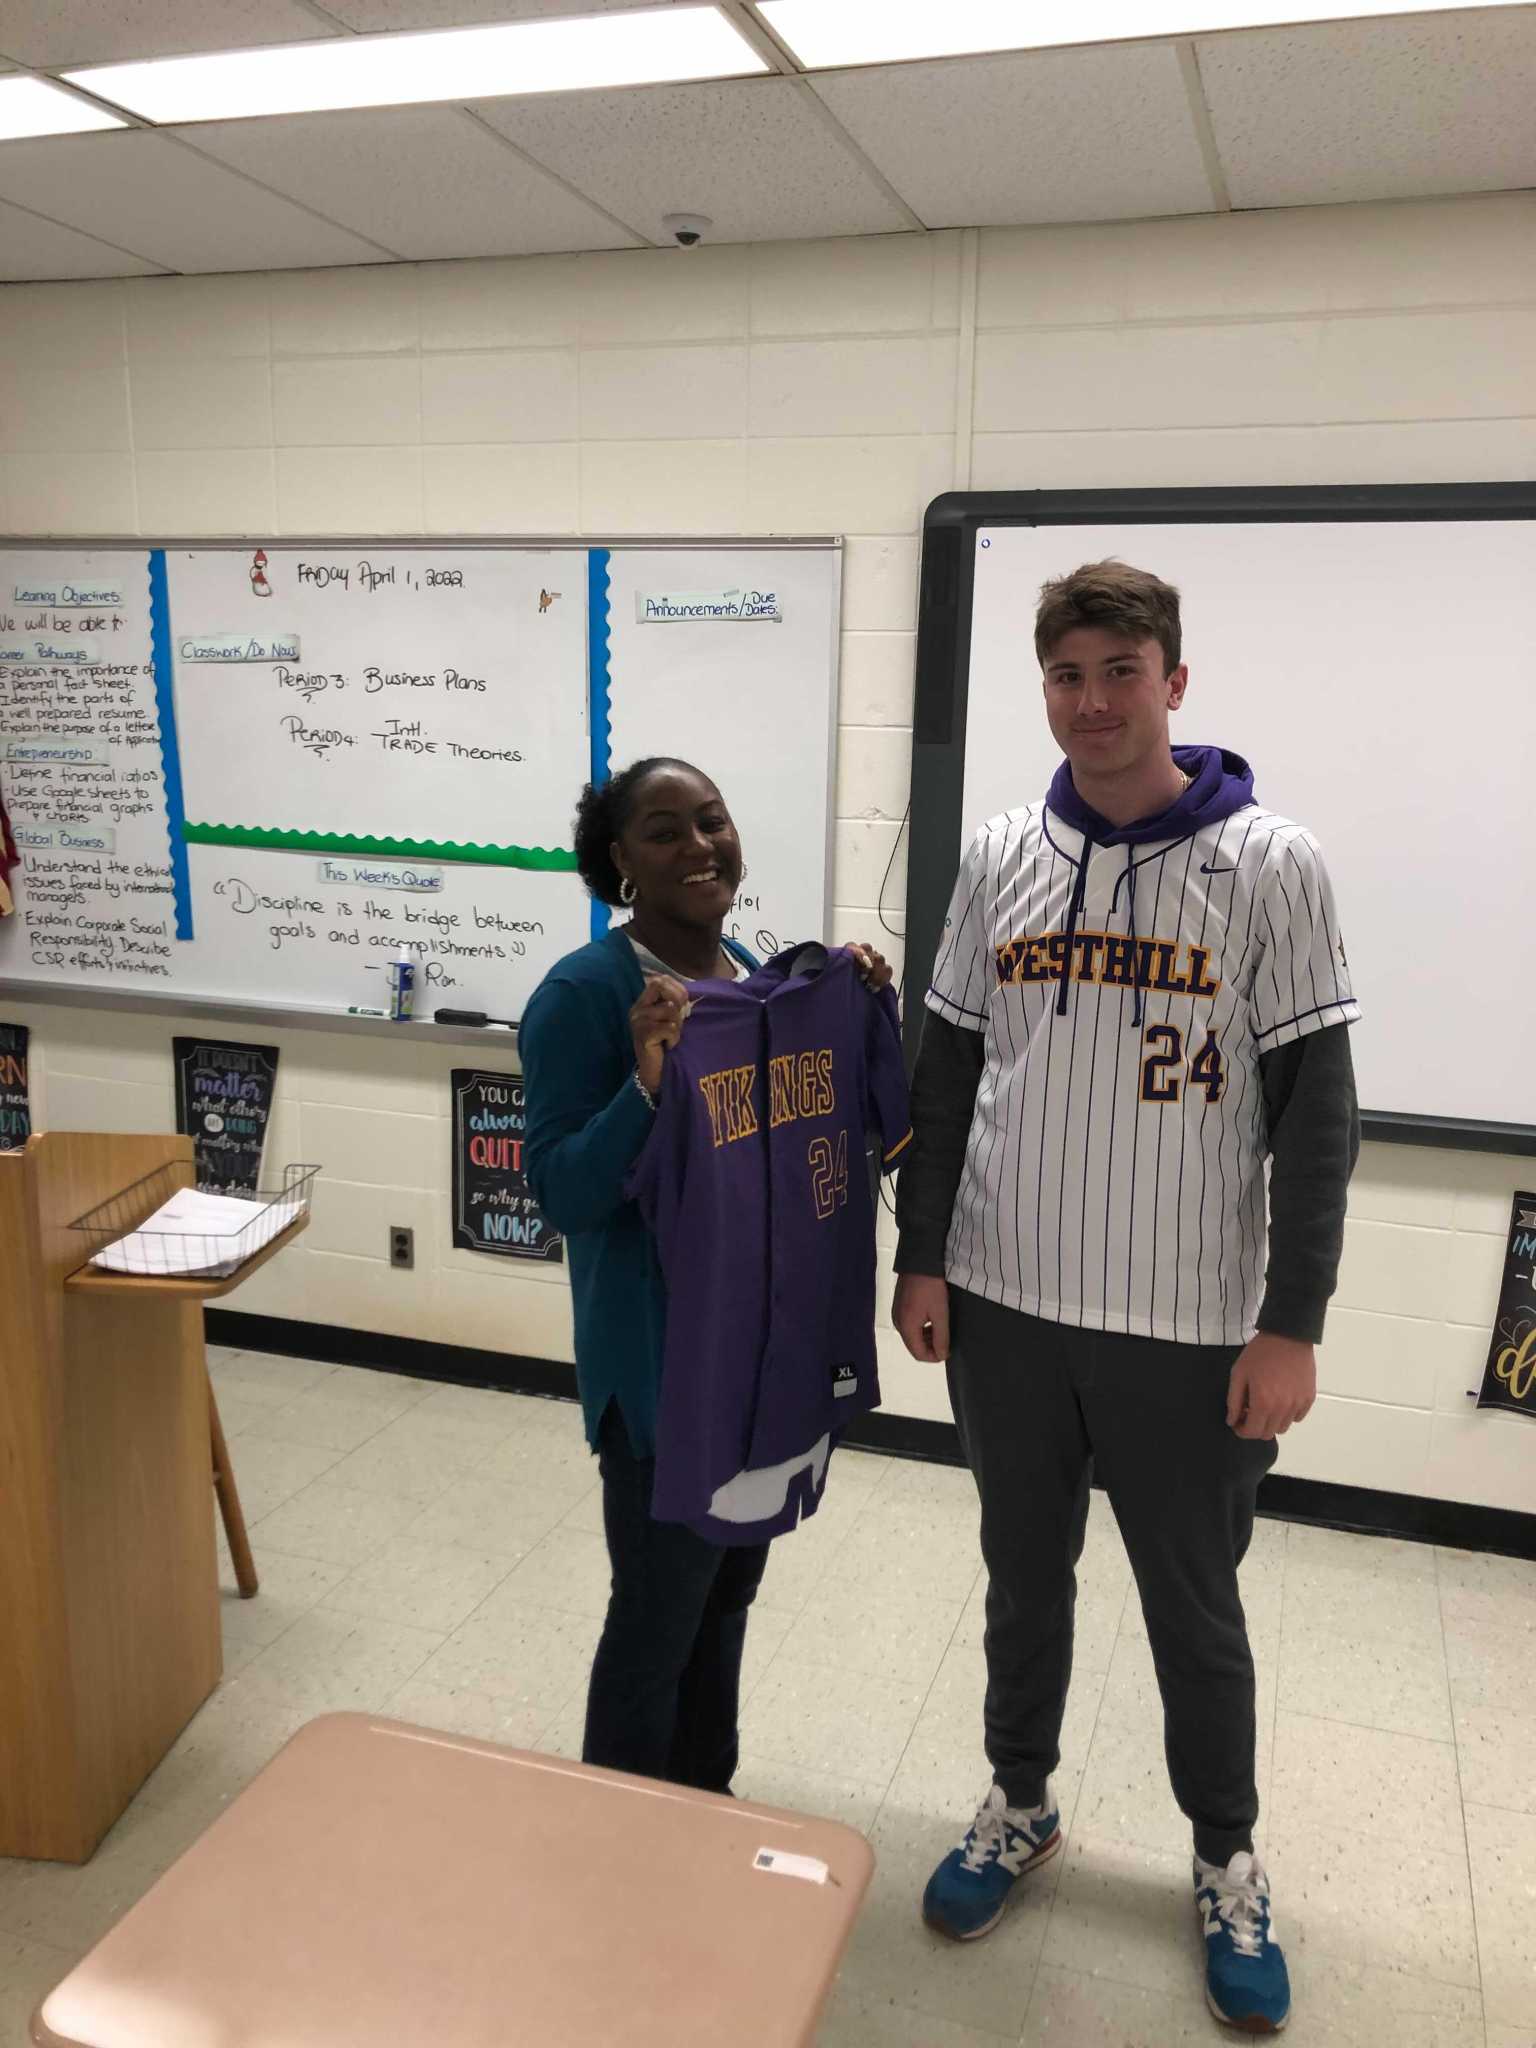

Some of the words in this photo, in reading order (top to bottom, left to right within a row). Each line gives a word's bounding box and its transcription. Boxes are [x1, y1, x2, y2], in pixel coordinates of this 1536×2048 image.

[357, 560, 396, 593] April
[751, 591, 776, 605] Due
[25, 613, 48, 631] will
[53, 614, 72, 633] be
[362, 667, 435, 693] Business
[444, 669, 488, 692] Plans
[57, 692, 78, 704] the
[83, 692, 114, 709] parts
[120, 689, 137, 707] of
[36, 706, 92, 721] prepared
[11, 784, 38, 797] Use
[134, 786, 150, 800] to
[110, 802, 154, 822] graphs
[24, 853, 102, 874] Understand
[107, 860, 130, 874] the
[323, 862, 348, 881] This
[23, 876, 66, 890] issues
[70, 875, 101, 890] faced
[105, 877, 120, 898] by
[26, 911, 72, 929] Explain
[130, 918, 167, 937] Social
[337, 901, 353, 916] is
[363, 900, 394, 921] the
[404, 904, 460, 937] bridge
[473, 906, 545, 935] between
[269, 921, 316, 949] goals
[327, 928, 360, 946] and
[120, 937, 172, 957] Describe
[32, 951, 64, 969] CSR
[995, 930, 1222, 999] WESTHILL
[1140, 1022, 1225, 1103] 24
[478, 1086, 508, 1104] YOU
[699, 1049, 836, 1148] VIKINGS
[470, 1135, 525, 1171] QUIT
[808, 1129, 849, 1220] 24
[483, 1212, 544, 1244] NOW?
[838, 1365, 854, 1378] XL
